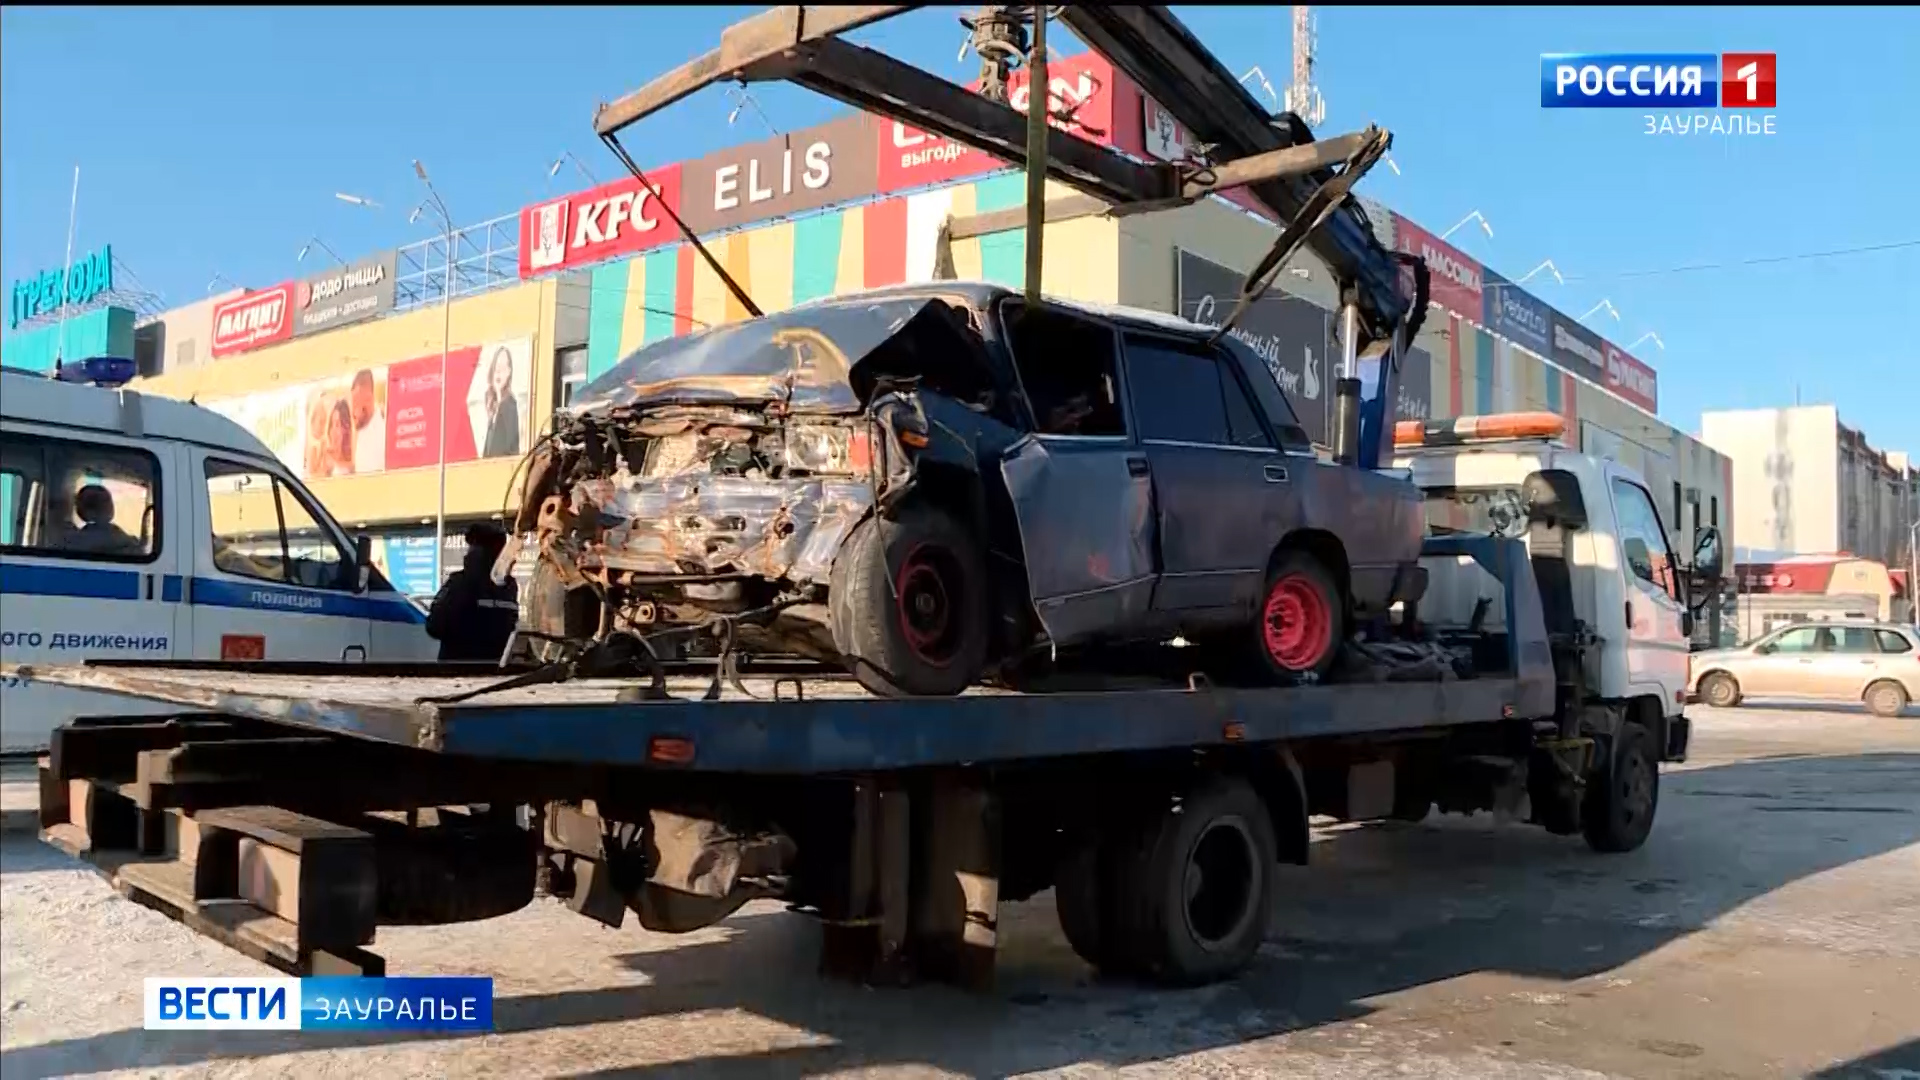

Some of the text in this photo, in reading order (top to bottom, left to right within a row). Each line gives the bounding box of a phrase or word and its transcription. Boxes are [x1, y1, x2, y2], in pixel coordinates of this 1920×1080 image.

[714, 141, 832, 212] ELIS
[571, 183, 662, 249] KFC
[311, 264, 384, 303] ДОДО ПИЦЦА
[217, 299, 282, 338] МАГНИТ
[49, 632, 168, 650] движения
